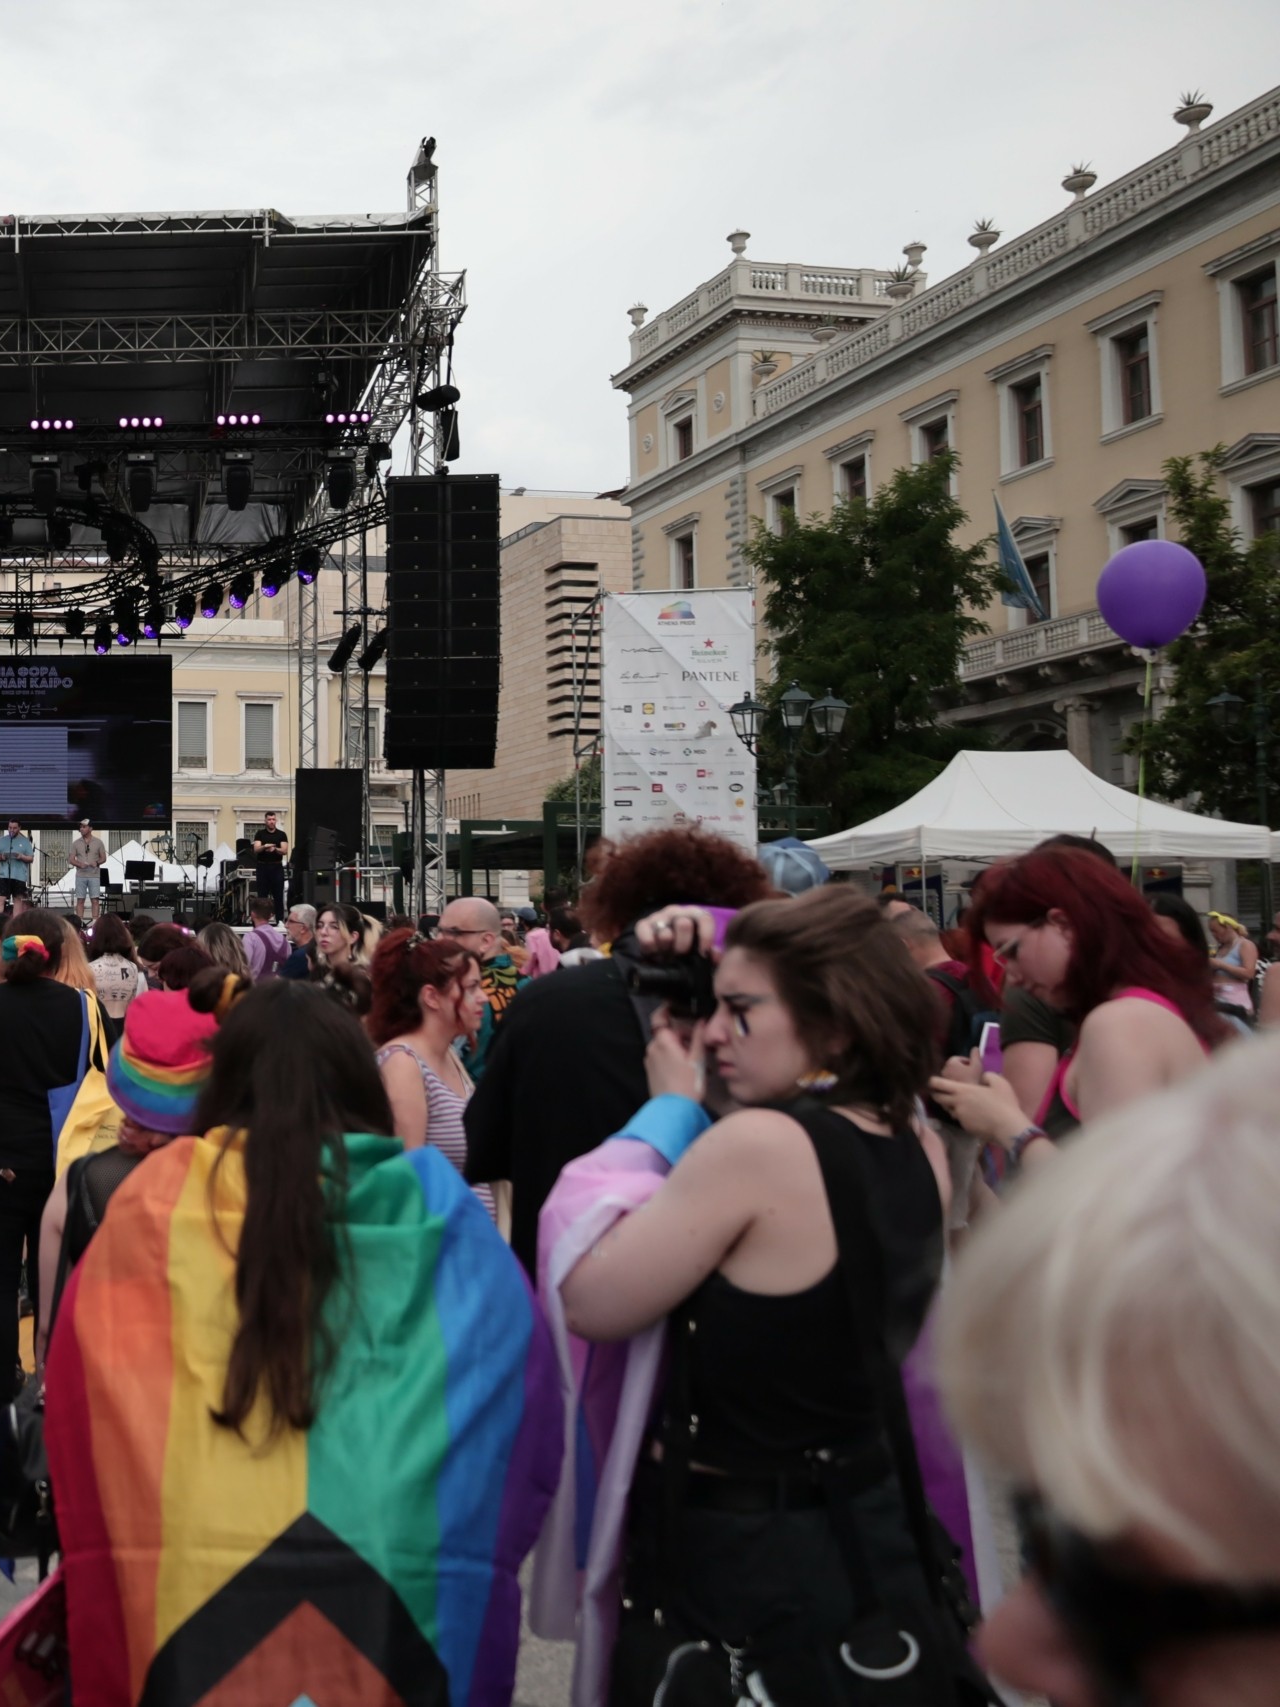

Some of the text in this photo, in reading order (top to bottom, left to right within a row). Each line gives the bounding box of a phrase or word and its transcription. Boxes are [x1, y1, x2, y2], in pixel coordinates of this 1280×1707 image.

[18, 666, 58, 677] ΦΟΡΑ
[682, 671, 740, 681] PANTENE
[30, 677, 73, 688] ΚΑΙΡΟ
